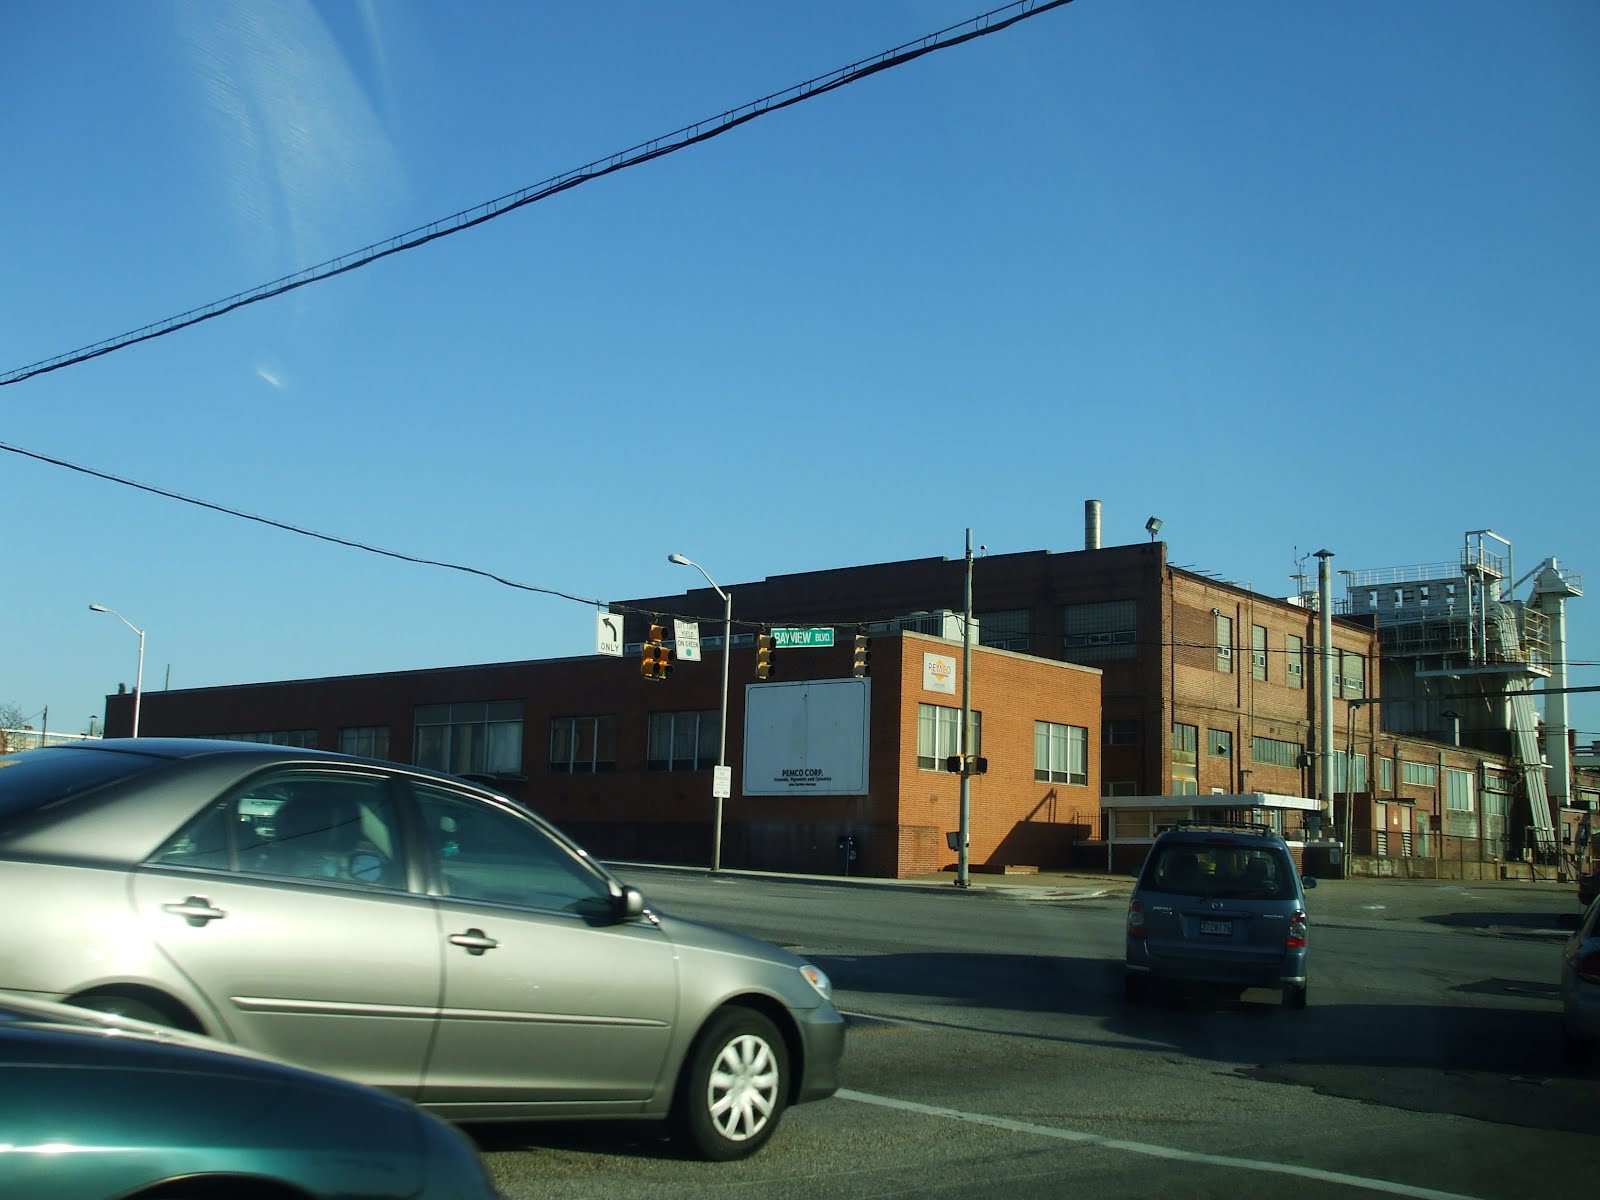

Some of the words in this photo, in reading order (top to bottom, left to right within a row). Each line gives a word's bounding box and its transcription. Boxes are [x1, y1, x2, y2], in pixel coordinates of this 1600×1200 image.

[601, 642, 619, 652] ONLY
[928, 662, 951, 675] PEMCO
[782, 769, 804, 777] PEMCO
[804, 768, 824, 777] CORP.
